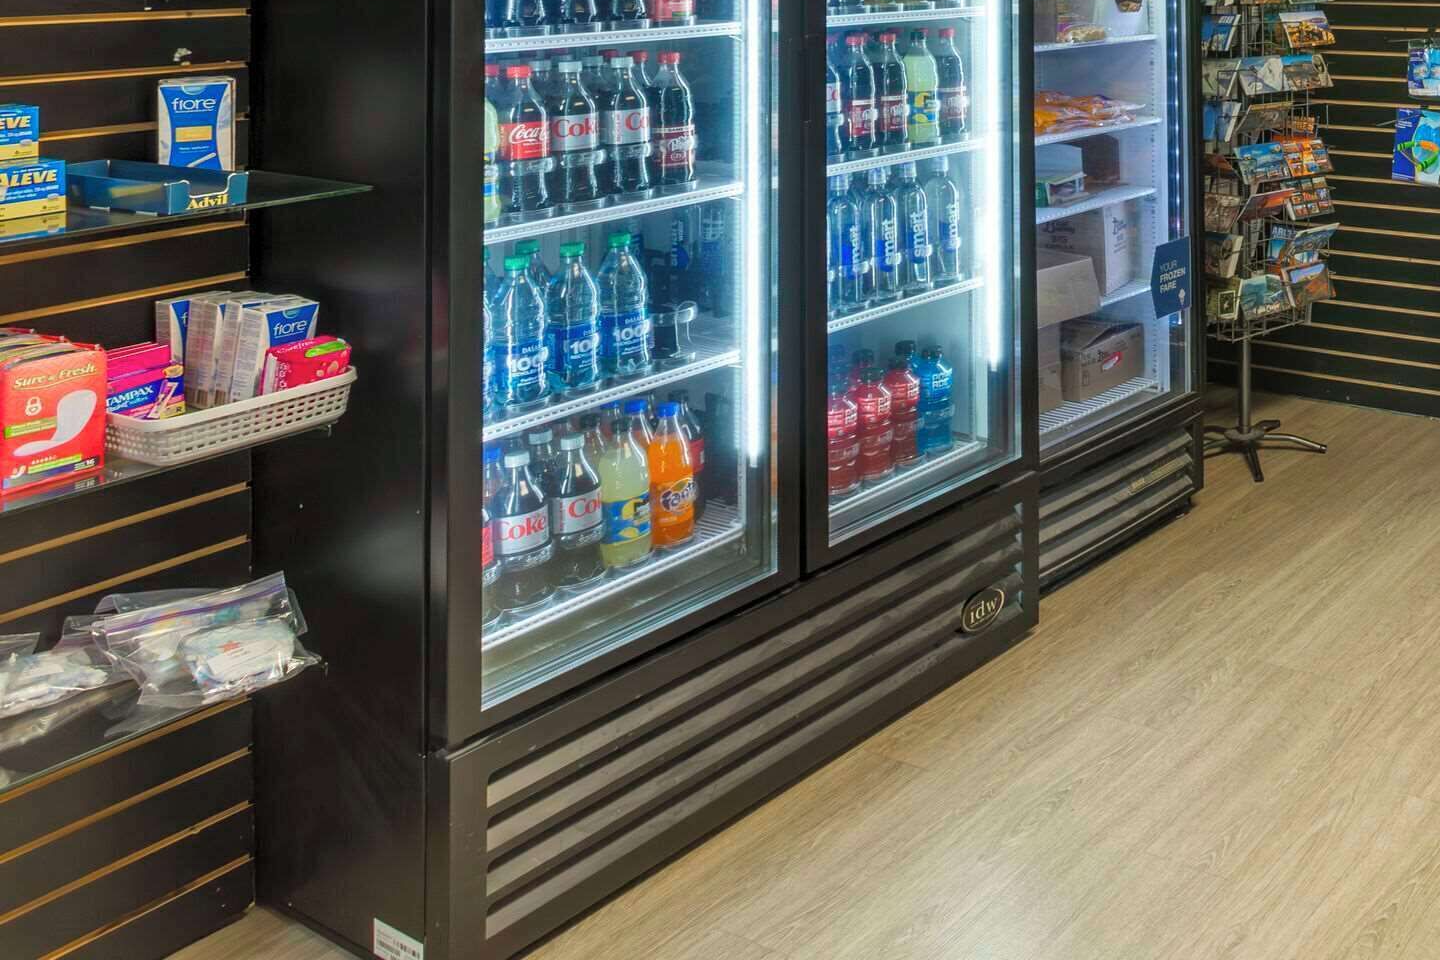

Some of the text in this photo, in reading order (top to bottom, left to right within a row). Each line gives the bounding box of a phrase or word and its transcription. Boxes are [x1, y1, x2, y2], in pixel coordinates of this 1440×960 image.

[625, 112, 649, 132] Co
[186, 194, 229, 210] Advil
[884, 218, 899, 266] smart
[912, 211, 927, 259] smart
[1159, 259, 1178, 271] YOUR
[1159, 267, 1186, 284] FROZEN
[1159, 280, 1177, 294] FARE
[14, 375, 46, 388] Sure
[60, 363, 96, 380] Fresh
[971, 597, 998, 624] idw
